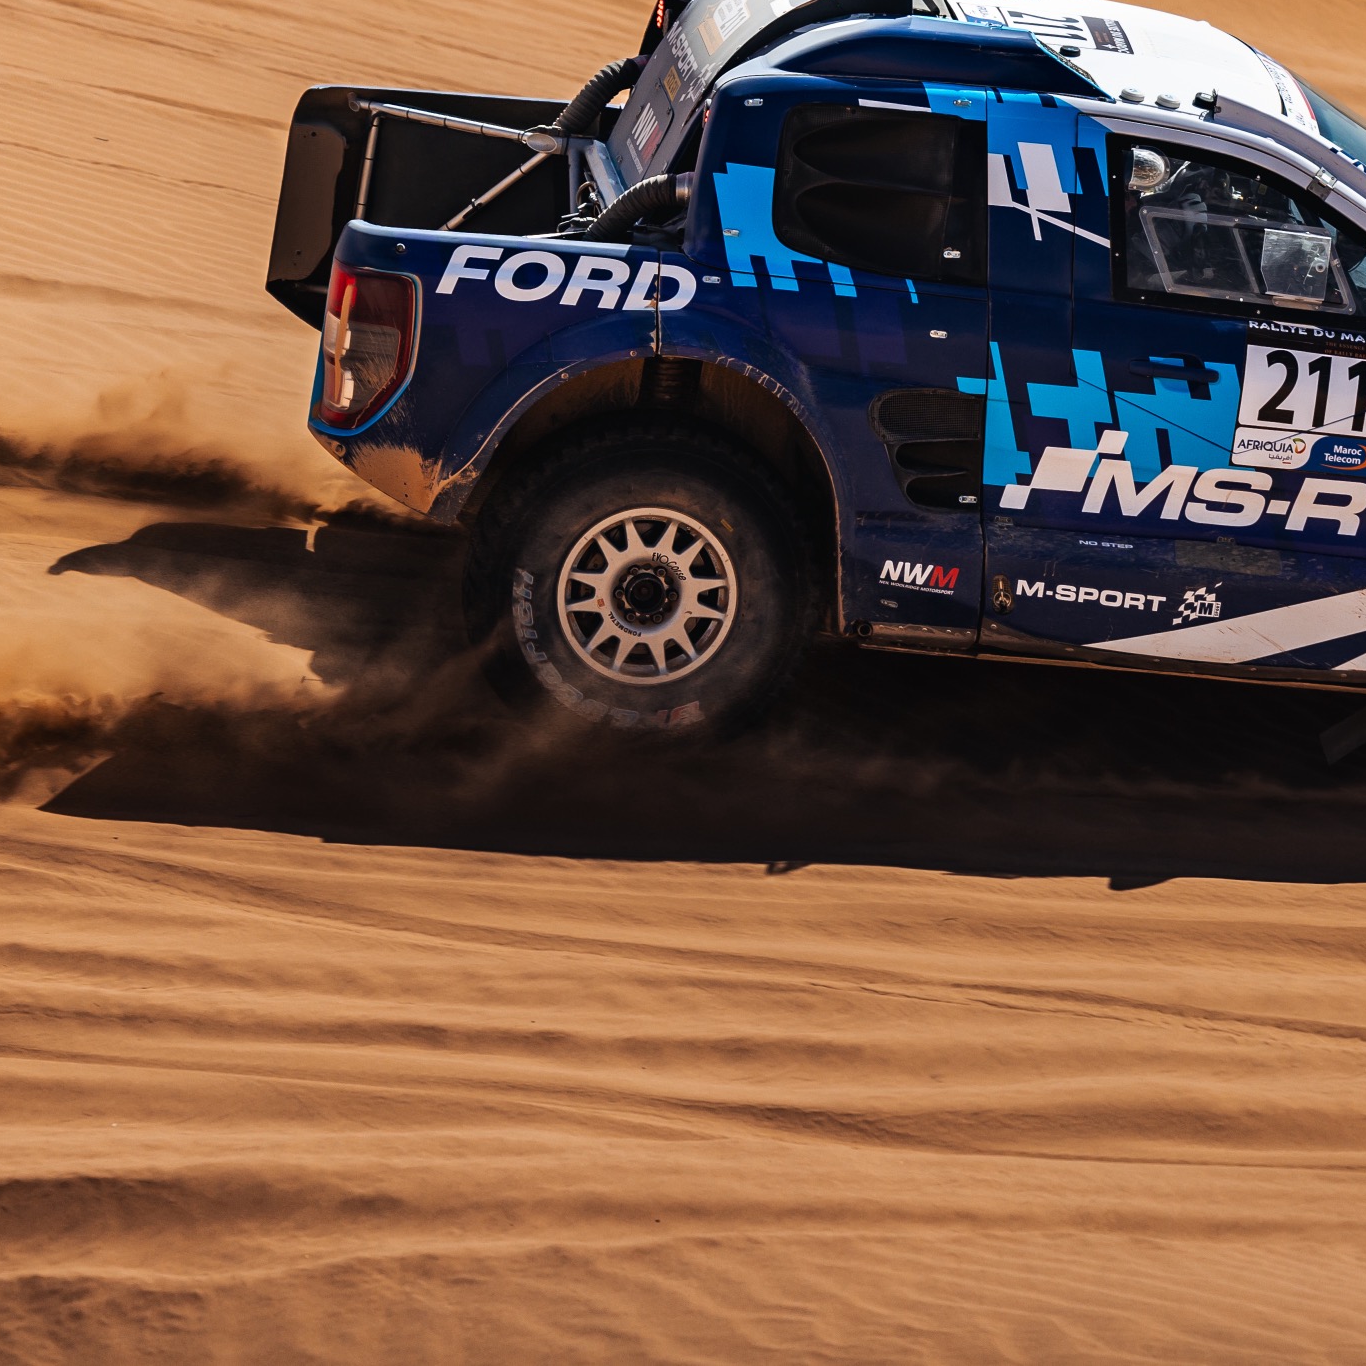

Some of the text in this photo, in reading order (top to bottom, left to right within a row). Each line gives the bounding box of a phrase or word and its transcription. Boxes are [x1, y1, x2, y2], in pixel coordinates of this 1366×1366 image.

[435, 244, 697, 311] FORD
[1248, 320, 1308, 336] RALLYE
[1313, 328, 1336, 339] DU
[1237, 439, 1294, 454] AFRIQUIA
[1333, 445, 1362, 456] Maroc
[1324, 452, 1361, 465] Telecom
[1101, 541, 1133, 549] STEP
[879, 559, 960, 589] NWM
[920, 586, 955, 595] MOTORSPORT
[1015, 579, 1166, 613] M-SPORT
[608, 611, 642, 637] FONDMETAL
